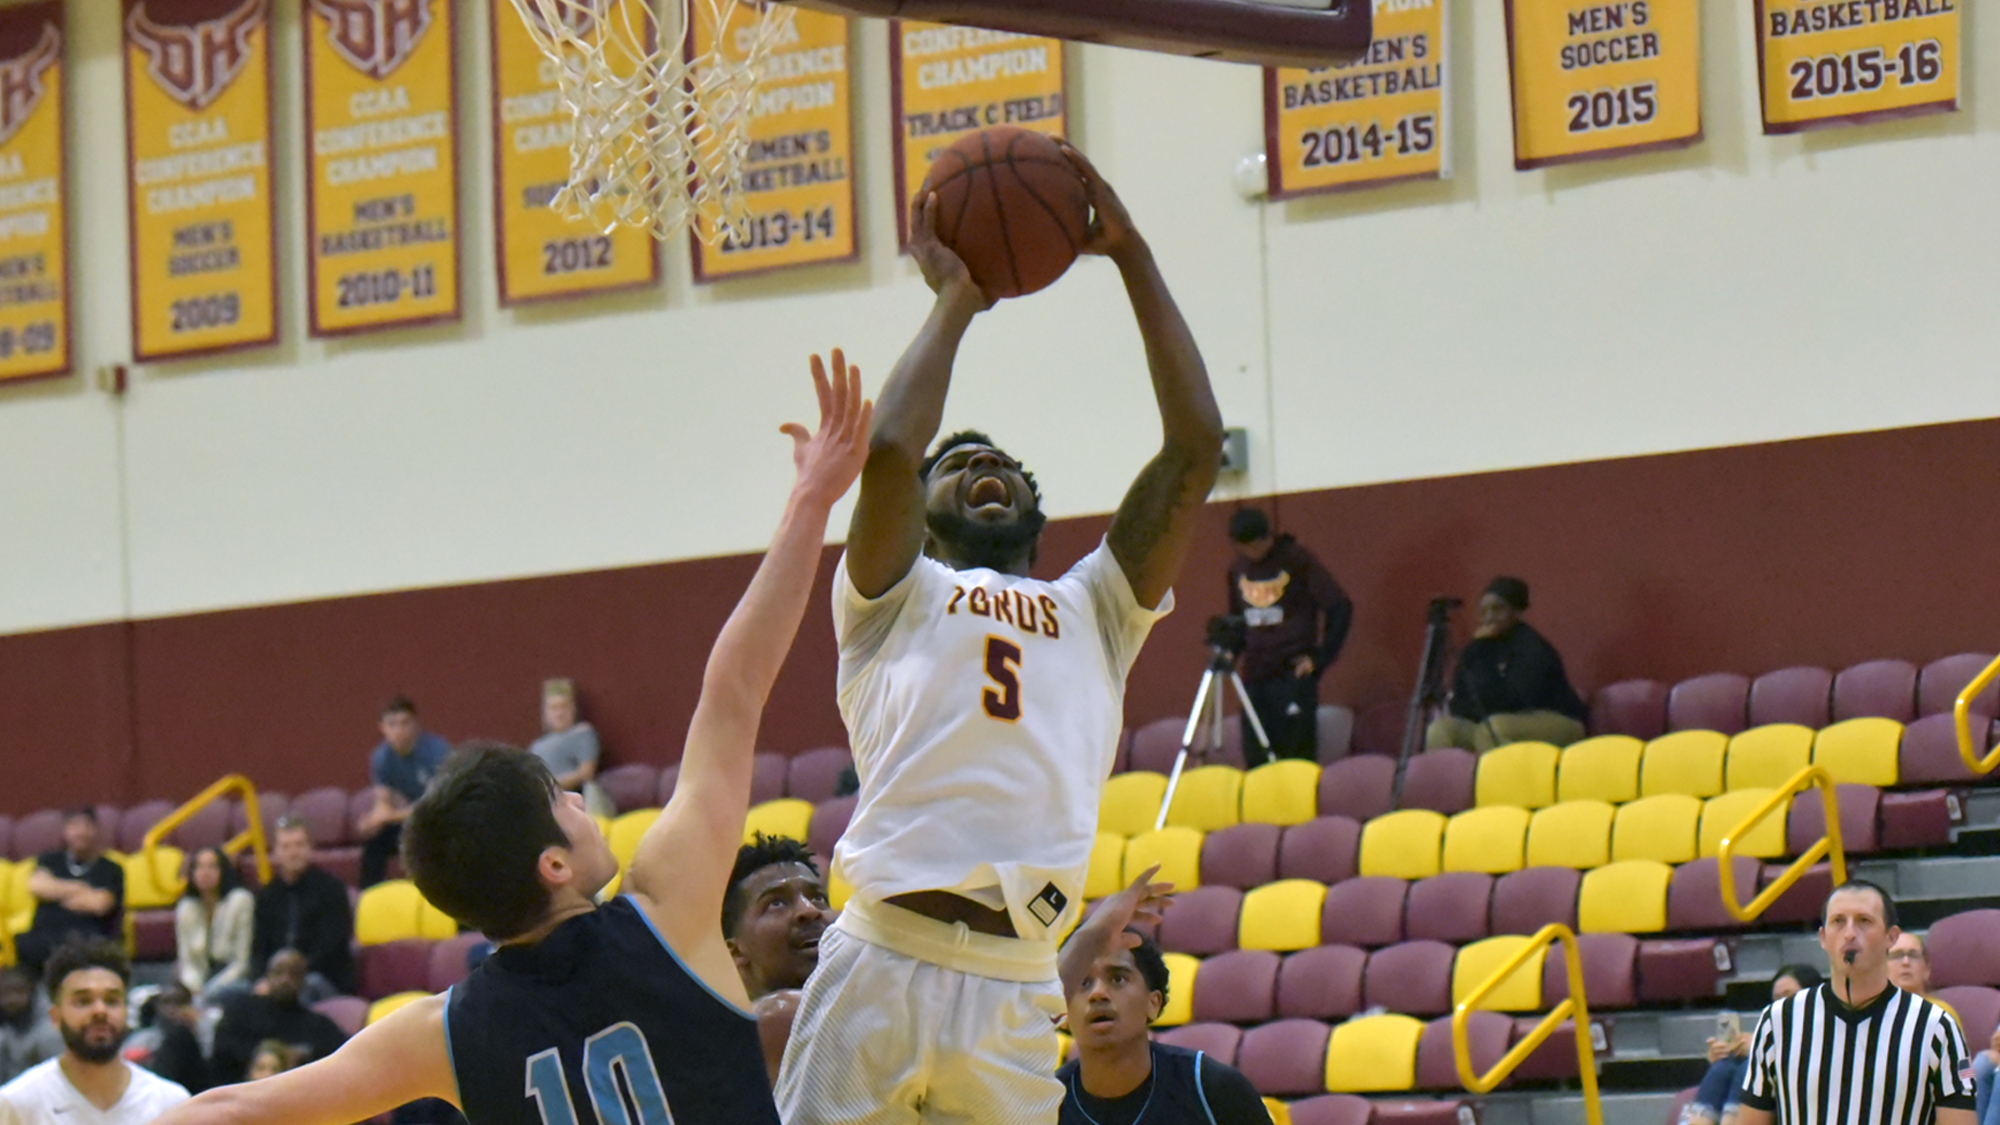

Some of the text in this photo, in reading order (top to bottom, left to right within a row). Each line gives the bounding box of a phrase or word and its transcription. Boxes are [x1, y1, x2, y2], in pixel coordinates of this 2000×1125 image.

[1567, 1, 1649, 37] MEN'S
[1769, 0, 1955, 37] BASKETBALL
[918, 46, 1048, 89] CHAMPION
[1560, 32, 1659, 71] SOCCER
[1788, 39, 1942, 101] 2015-16
[907, 105, 981, 138] TRACK
[1003, 92, 1062, 124] FIELD
[1567, 81, 1657, 133] 2015
[315, 111, 447, 154] CONFERENCE
[1300, 114, 1435, 168] 2014-15
[326, 147, 438, 186] CHAMPION
[321, 219, 448, 256] BASKETBALL
[543, 235, 613, 275] 2012
[337, 266, 436, 308] 2010-11
[980, 633, 1024, 724] 5
[525, 1020, 676, 1125] 10
